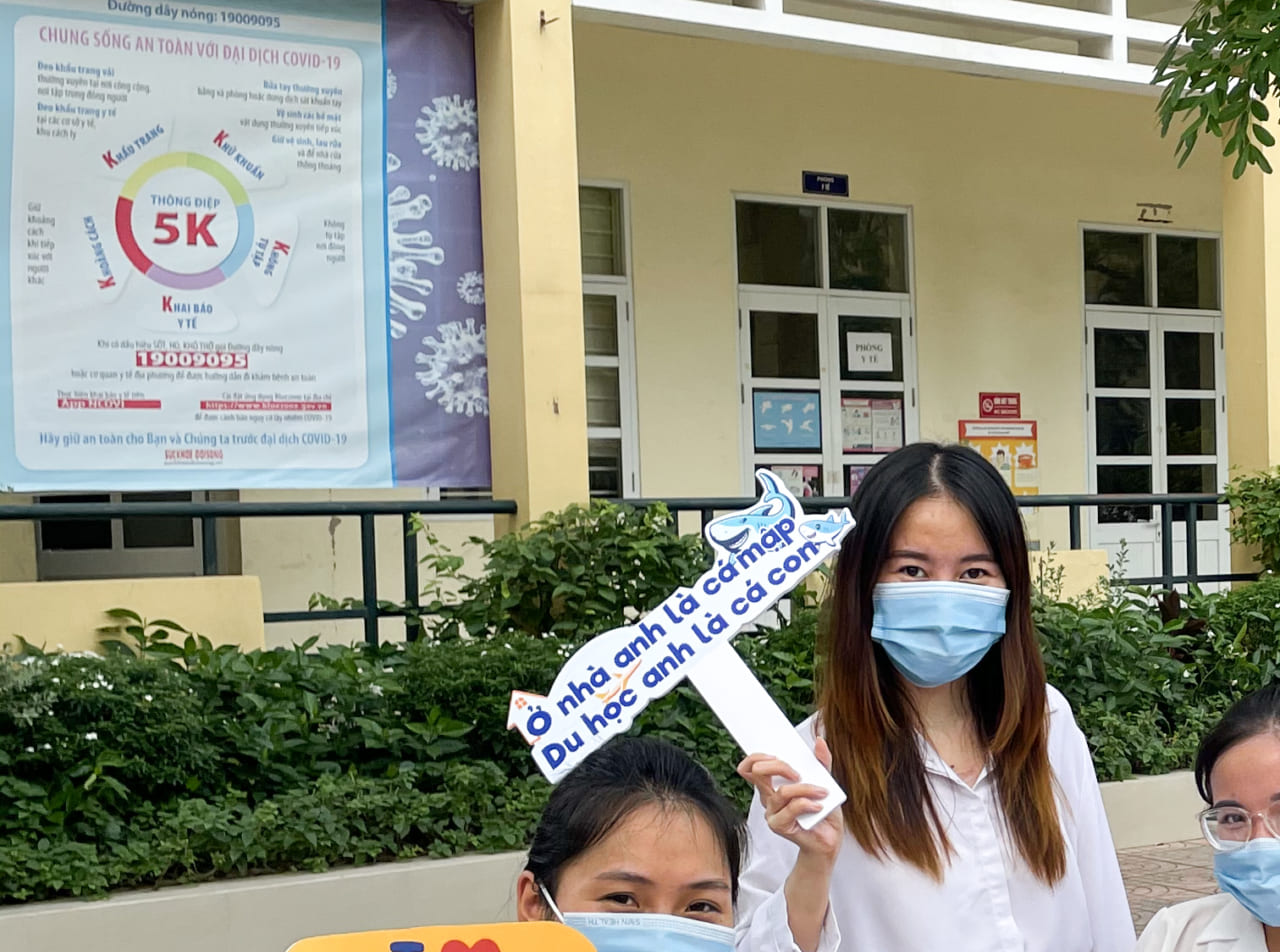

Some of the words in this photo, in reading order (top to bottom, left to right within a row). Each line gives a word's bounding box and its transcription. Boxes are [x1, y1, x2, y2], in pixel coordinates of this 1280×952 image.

[220, 11, 281, 28] 19009095
[39, 25, 90, 46] CHUNG
[93, 28, 131, 50] SỐNG
[135, 36, 154, 52] AN
[157, 37, 193, 57] TOÀN
[283, 51, 341, 70] COVID-19
[150, 193, 191, 207] THÔNG
[152, 211, 219, 248] 5K
[138, 352, 247, 368] 19009095
[126, 433, 144, 445] cho
[219, 434, 230, 445] ta
[302, 433, 348, 446] COVID-19
[526, 705, 552, 737] Ở
[556, 665, 612, 716] nhà
[613, 620, 667, 669] anh
[662, 593, 701, 624] là
[702, 561, 740, 596] cá
[739, 518, 796, 570] mập
[541, 729, 585, 771] Du
[580, 688, 638, 736] học
[641, 641, 696, 689] anh
[691, 612, 730, 644] là
[730, 579, 768, 616] cá
[767, 541, 821, 587] con
